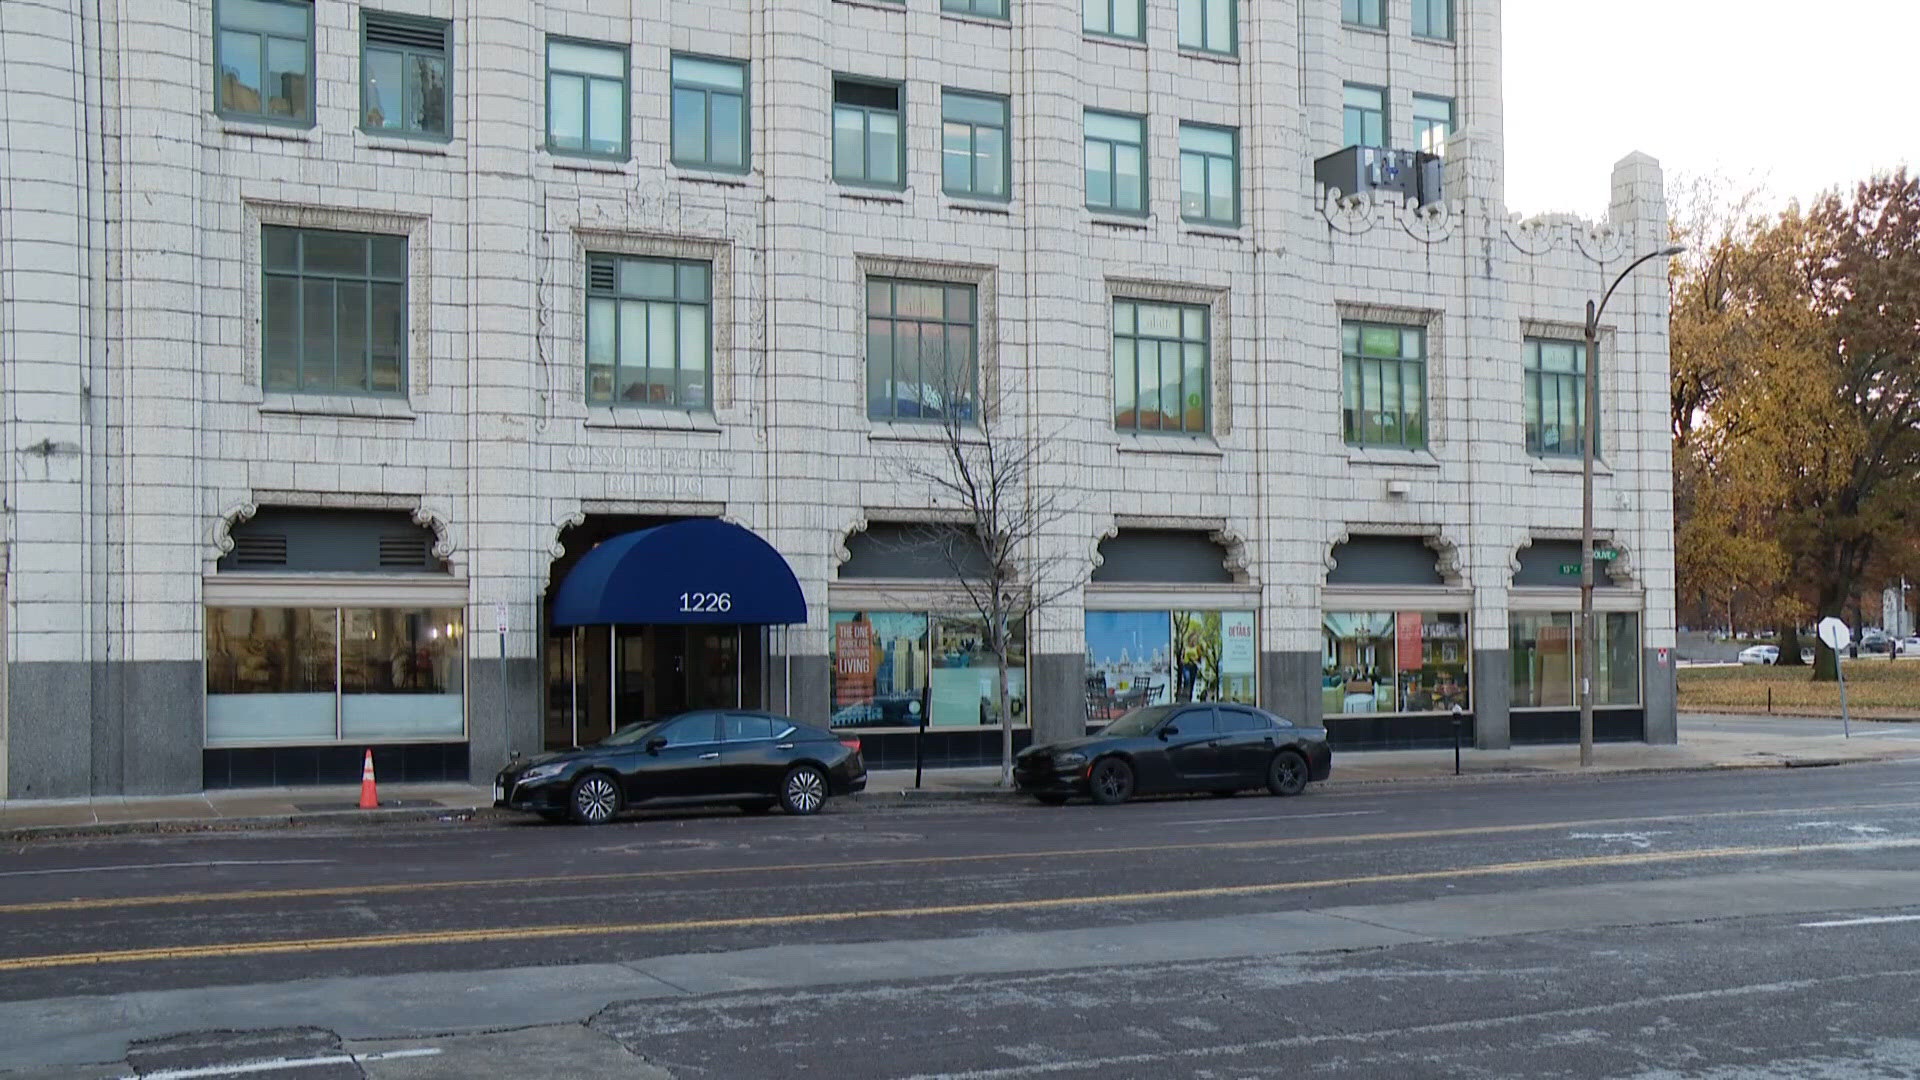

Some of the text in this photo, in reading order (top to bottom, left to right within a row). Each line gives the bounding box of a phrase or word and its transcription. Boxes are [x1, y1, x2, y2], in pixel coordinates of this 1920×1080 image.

[567, 446, 735, 469] MISSOURI PACIFIC
[608, 474, 701, 494] BUILDING
[1594, 550, 1611, 560] OLIVE
[680, 592, 731, 612] 1226
[840, 626, 869, 639] THE ONE
[839, 658, 870, 673] LIVING
